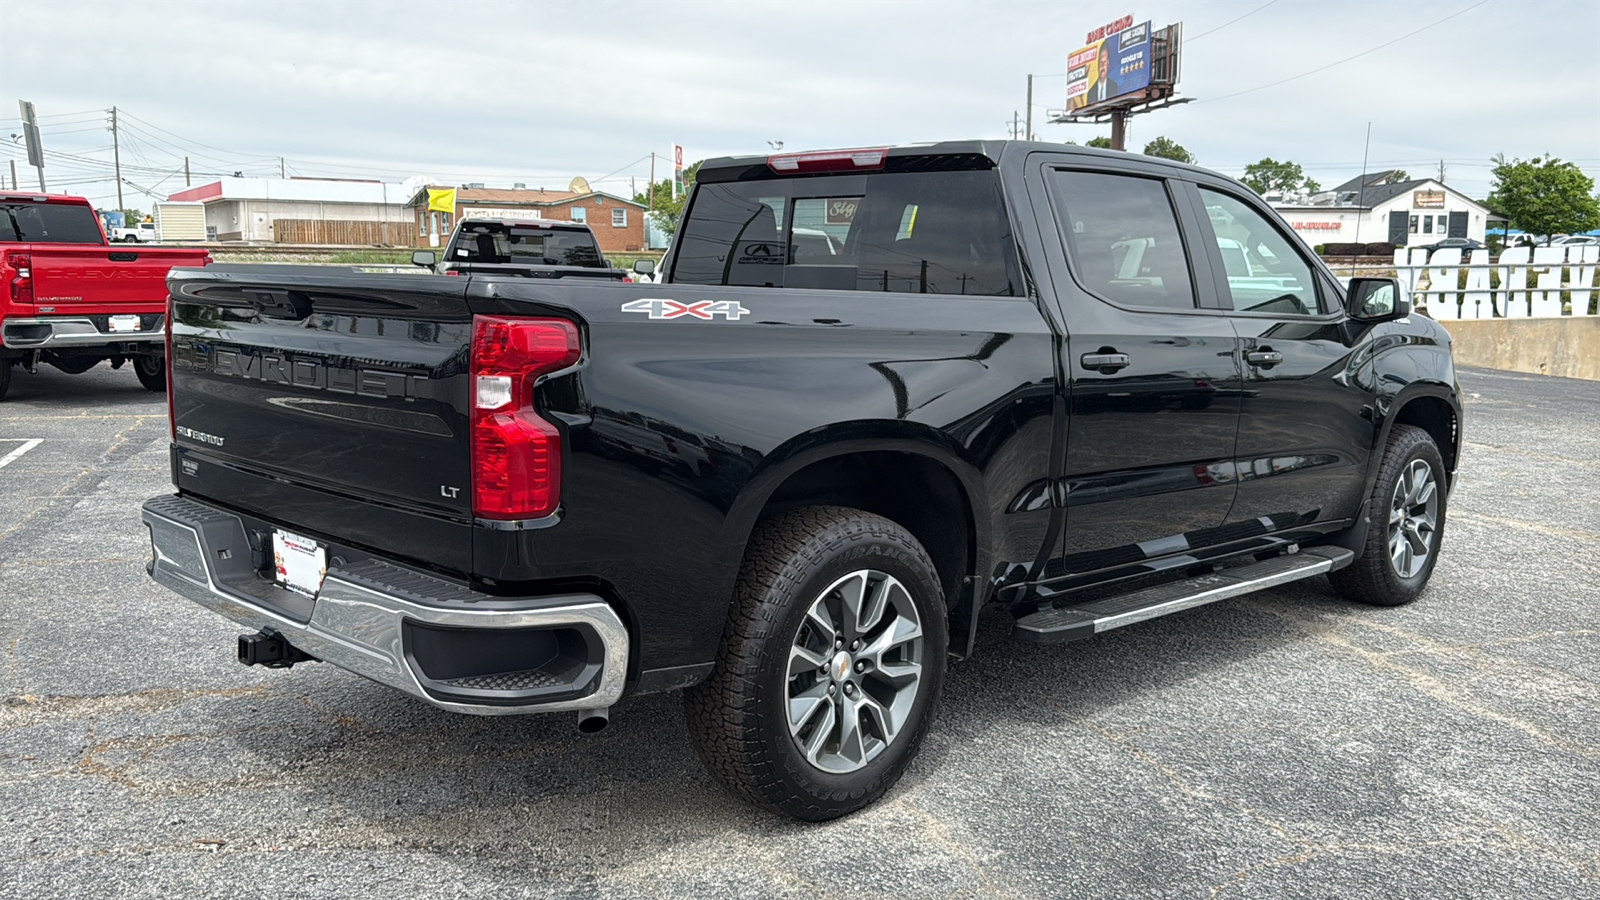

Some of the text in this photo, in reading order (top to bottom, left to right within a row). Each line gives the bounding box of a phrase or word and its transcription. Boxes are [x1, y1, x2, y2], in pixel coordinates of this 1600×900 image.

[175, 342, 429, 402] CHEVROLET
[176, 425, 225, 446] SILVERADO
[440, 485, 460, 499] LT
